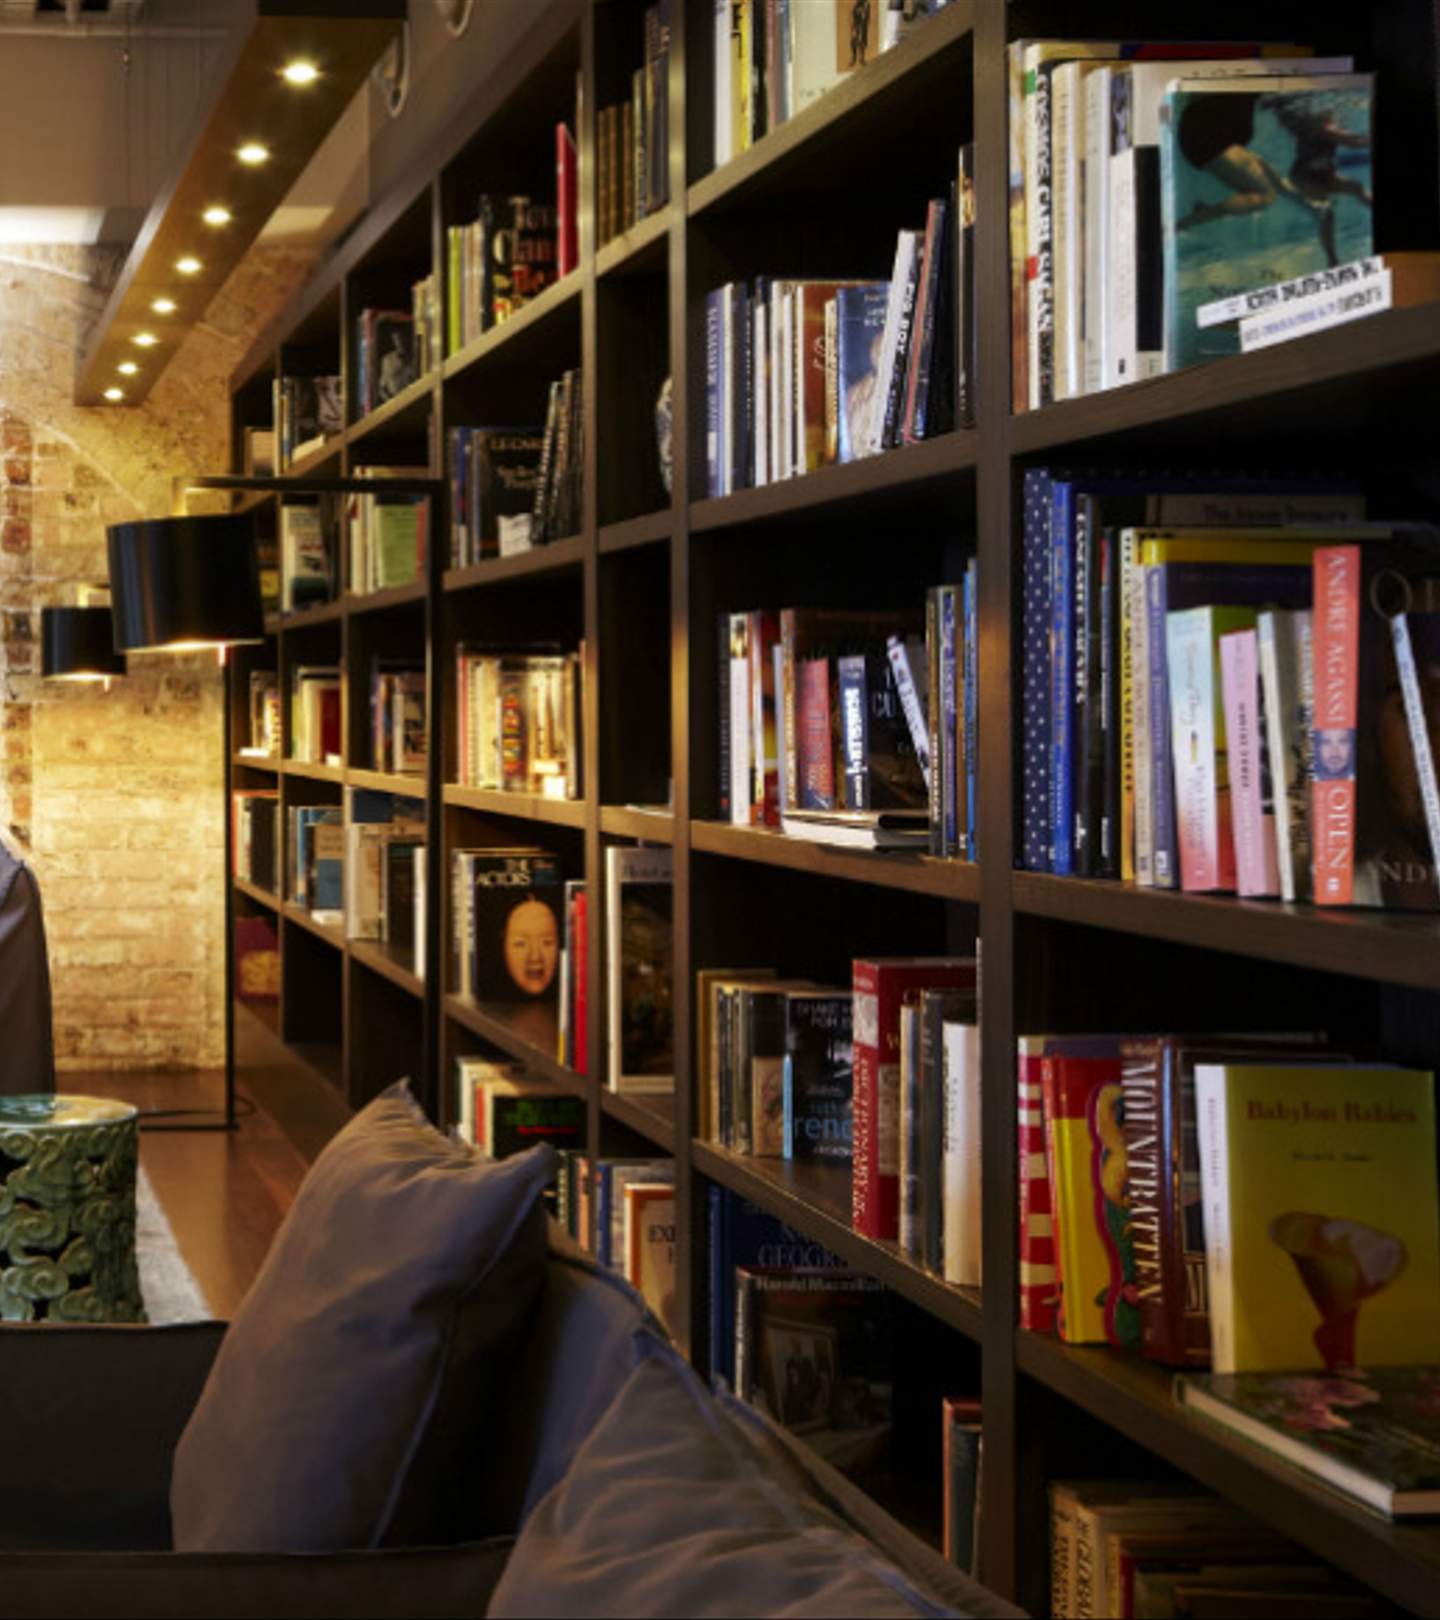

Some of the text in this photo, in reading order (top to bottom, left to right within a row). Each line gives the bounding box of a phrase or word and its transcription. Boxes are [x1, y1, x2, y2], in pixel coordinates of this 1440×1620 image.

[1326, 554, 1347, 723] ANDRE AGASSI
[1327, 786, 1349, 870] OPEN
[1246, 1099, 1418, 1125] Babylon Babies
[1122, 1060, 1163, 1303] MOUNTBATTEN
